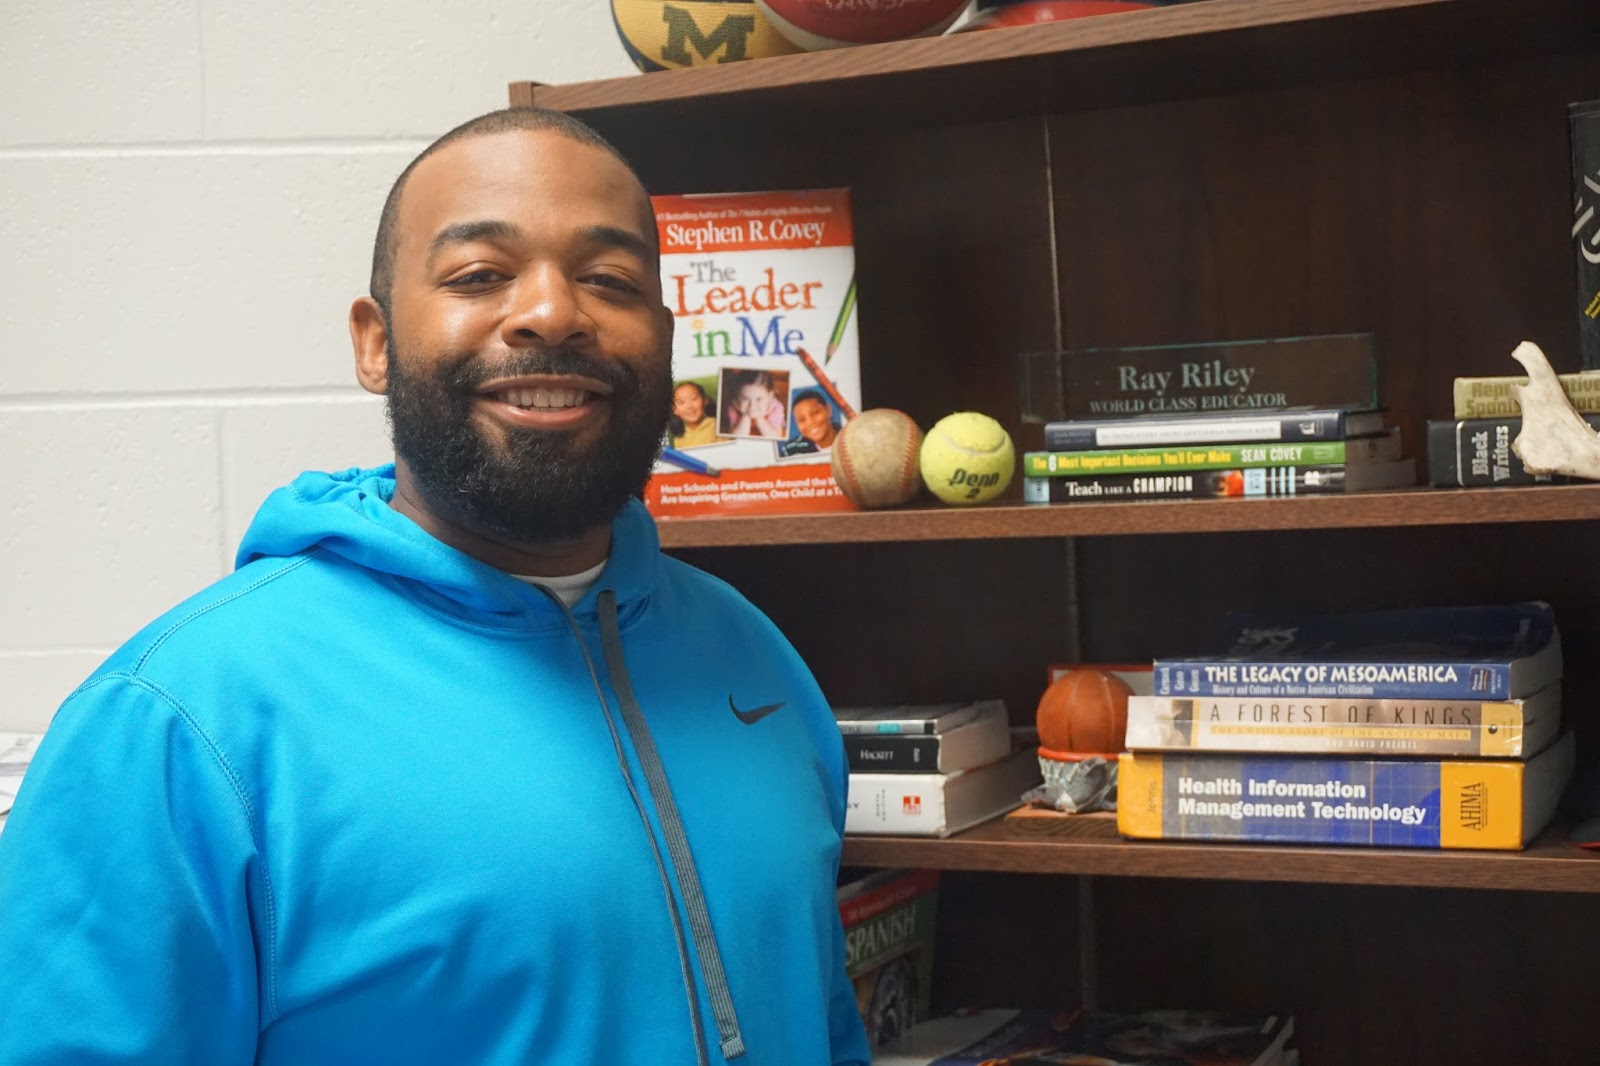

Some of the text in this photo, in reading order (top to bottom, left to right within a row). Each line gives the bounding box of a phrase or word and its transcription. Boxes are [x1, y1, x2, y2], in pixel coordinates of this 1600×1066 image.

[661, 4, 755, 65] M
[666, 218, 825, 250] Stephen R. Covey
[690, 260, 736, 283] The
[670, 267, 822, 317] Leader
[691, 315, 804, 358] in Me
[1118, 360, 1255, 396] Ray Riley
[1090, 392, 1287, 413] WORLD CLASS EDUCATOR
[1032, 457, 1047, 469] The
[1048, 454, 1057, 472] 6
[1058, 456, 1078, 469] Most
[1080, 455, 1120, 470] Important
[1122, 453, 1161, 466] Decisions
[1187, 451, 1207, 464] Ever
[1208, 450, 1231, 463] Make
[1240, 448, 1266, 463] SEAN
[1270, 447, 1302, 462] COVEY
[1471, 431, 1489, 476] Black
[1492, 425, 1510, 482] Writers
[660, 485, 682, 495] How
[683, 482, 719, 493] Schools
[721, 481, 738, 491] and
[739, 480, 774, 490] Parents
[776, 478, 810, 488] Around
[811, 477, 827, 487] the
[947, 467, 999, 487] Penn
[1065, 481, 1102, 496] Teach
[1104, 486, 1124, 495] LIKE
[1133, 475, 1193, 493] CHAMPION
[660, 494, 678, 504] Are
[679, 493, 720, 505] Inspiring
[769, 490, 789, 499] One
[790, 488, 815, 498] Child
[816, 488, 826, 497] at
[1205, 666, 1238, 682] THE
[1241, 666, 1302, 683] LEGACY
[1304, 666, 1327, 682] OF
[1330, 665, 1458, 683] MESOAMERICA
[1212, 684, 1235, 696] History
[1236, 684, 1248, 695] and
[1249, 684, 1271, 695] Culture
[1272, 684, 1280, 694] of
[1286, 684, 1306, 695] Native
[1307, 684, 1336, 695] American
[1337, 684, 1374, 695] Civilization
[1210, 703, 1472, 725] A FOREST OF KINGS
[1348, 739, 1375, 749] DAVID
[1437, 730, 1470, 739] MAYA
[1178, 777, 1366, 799] Health Information
[1178, 798, 1426, 825] Management Technology
[1460, 783, 1481, 831] AHIMA
